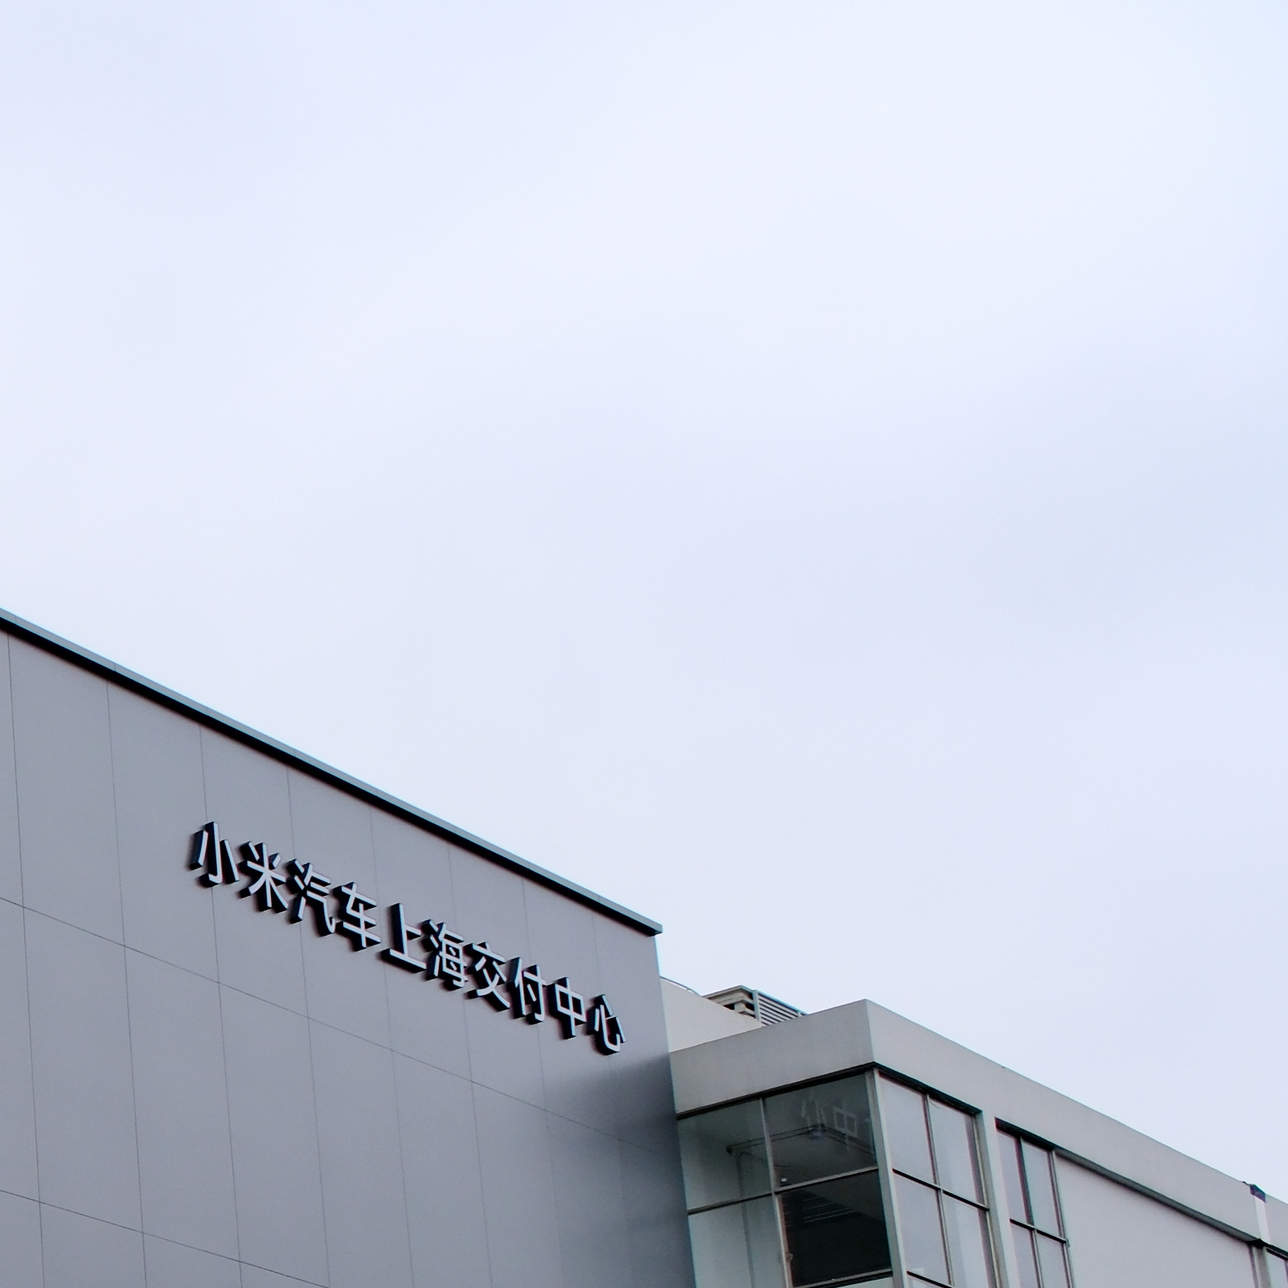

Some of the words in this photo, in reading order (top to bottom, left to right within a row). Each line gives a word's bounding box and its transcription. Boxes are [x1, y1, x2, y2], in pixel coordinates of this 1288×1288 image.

[188, 821, 627, 1056] 小米汽车上海交付中心
